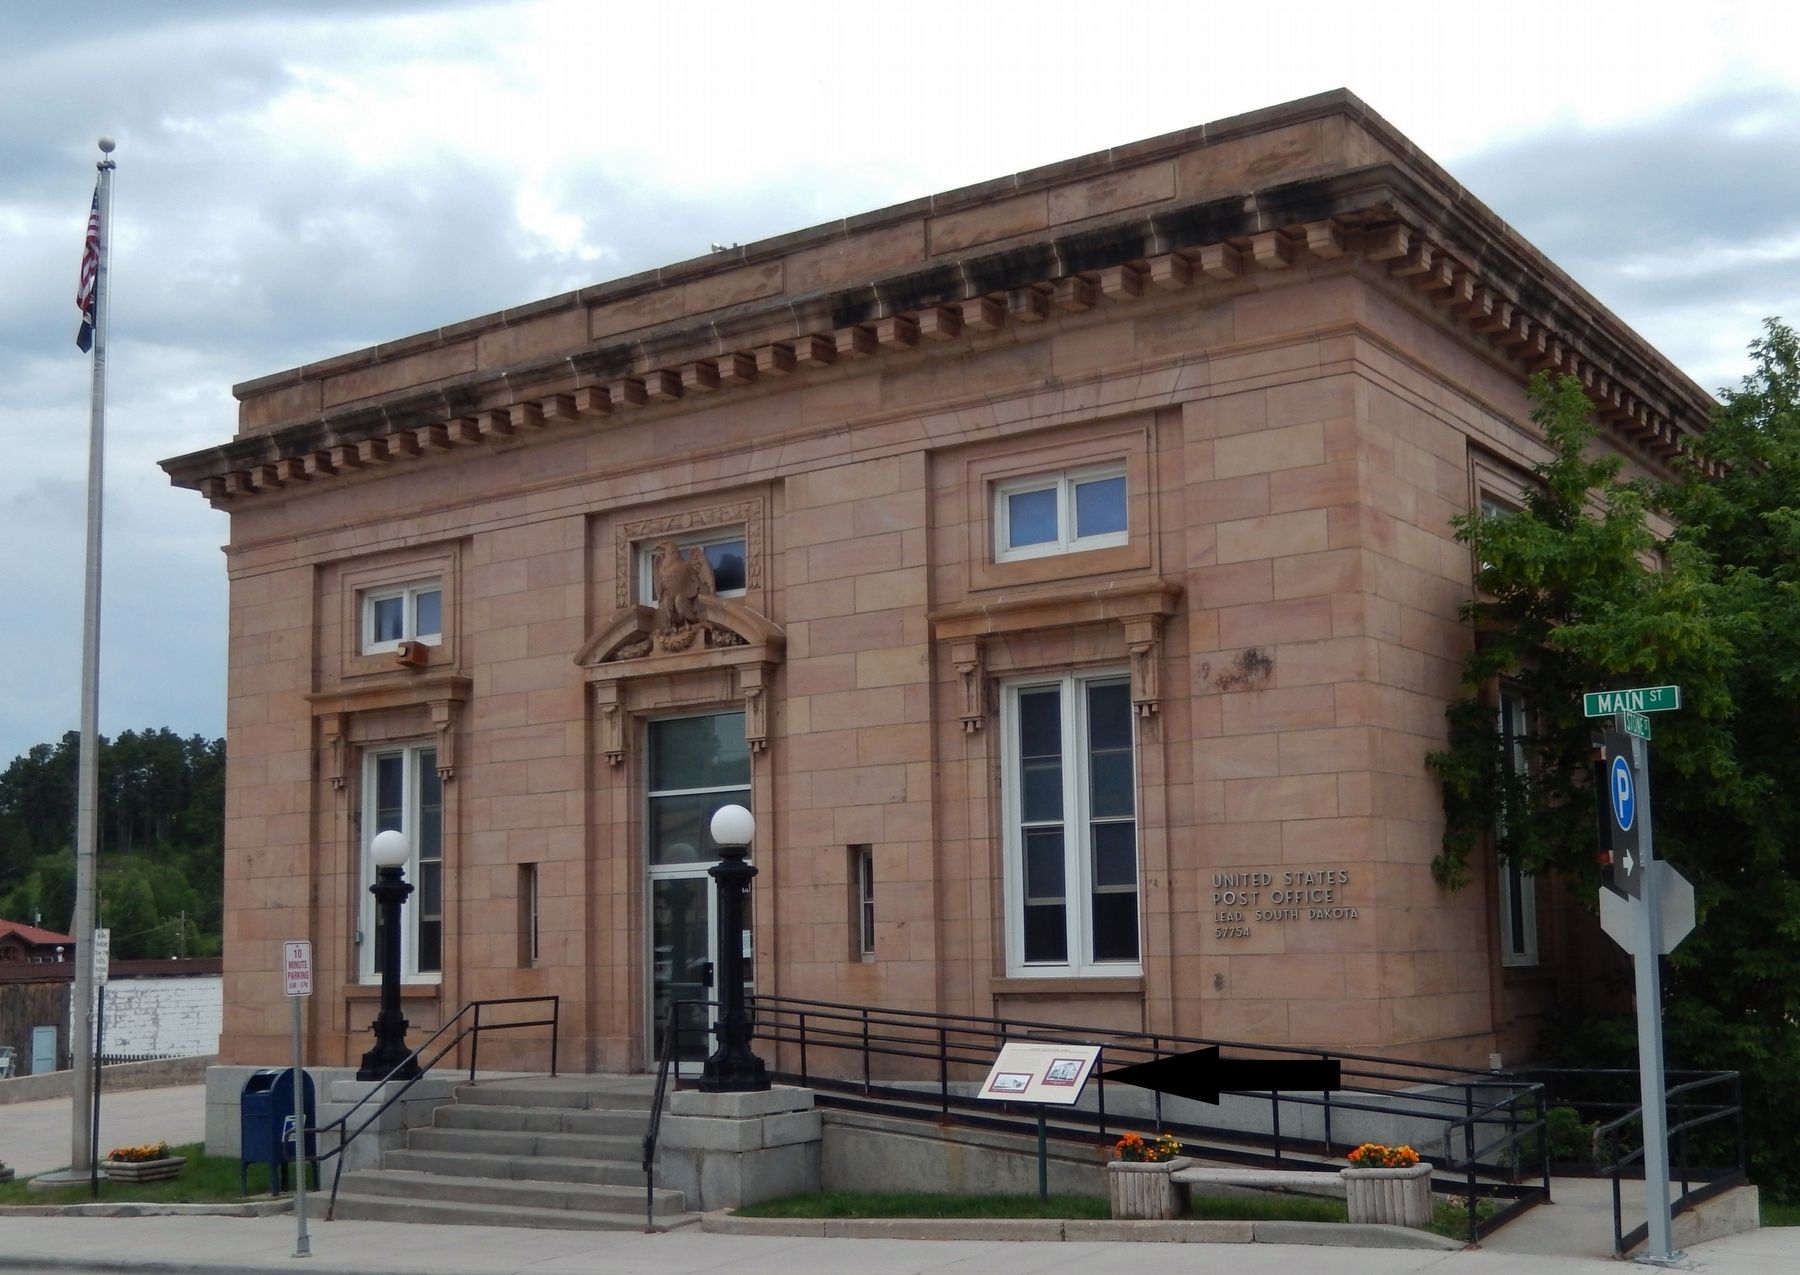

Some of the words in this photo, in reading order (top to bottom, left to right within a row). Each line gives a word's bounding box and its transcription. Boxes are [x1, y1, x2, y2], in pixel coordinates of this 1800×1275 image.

[1597, 691, 1644, 713] MAIN
[1649, 689, 1662, 702] ST
[1616, 768, 1629, 819] P
[1212, 872, 1272, 888] UNITED
[1284, 869, 1348, 886] STATES
[1213, 891, 1259, 905] POST
[1271, 889, 1334, 904] OFFICE
[1255, 909, 1300, 921] SOUTH
[1308, 907, 1359, 920] DAKOTA
[1215, 927, 1251, 938] 57754
[294, 949, 303, 958] 10
[288, 960, 308, 969] MINUTE
[287, 971, 309, 980] PARKING
